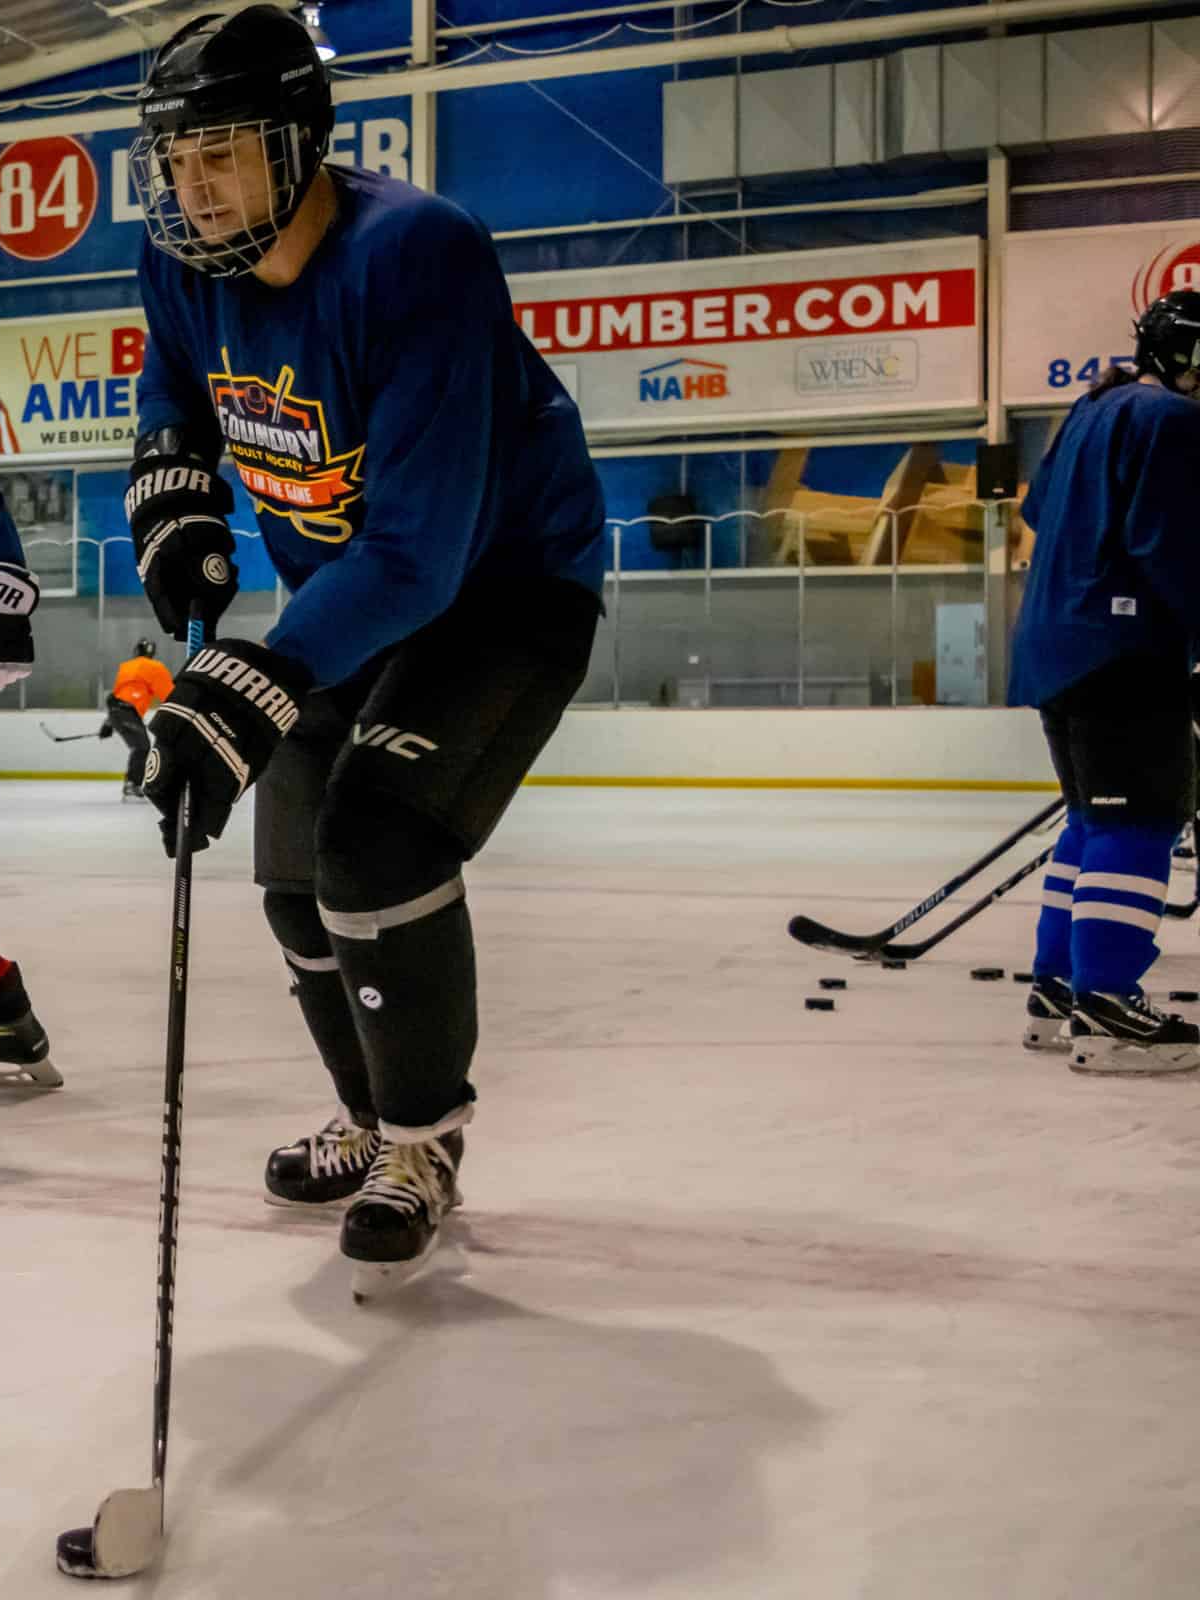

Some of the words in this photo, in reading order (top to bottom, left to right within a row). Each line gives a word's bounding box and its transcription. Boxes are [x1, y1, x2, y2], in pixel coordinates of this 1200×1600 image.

[280, 64, 313, 82] BAUER
[145, 99, 185, 114] BAUER
[521, 278, 940, 351] LUMBER.COM
[20, 331, 100, 382] WE
[21, 378, 145, 424] AME
[639, 374, 727, 402] NAHB
[40, 427, 138, 445] WEBUILDA
[217, 405, 322, 463] FOUNDRY
[265, 452, 303, 473] HOCKEY
[124, 467, 211, 523] RRIOR
[284, 482, 314, 504] GAME
[185, 648, 300, 738] WARRIO
